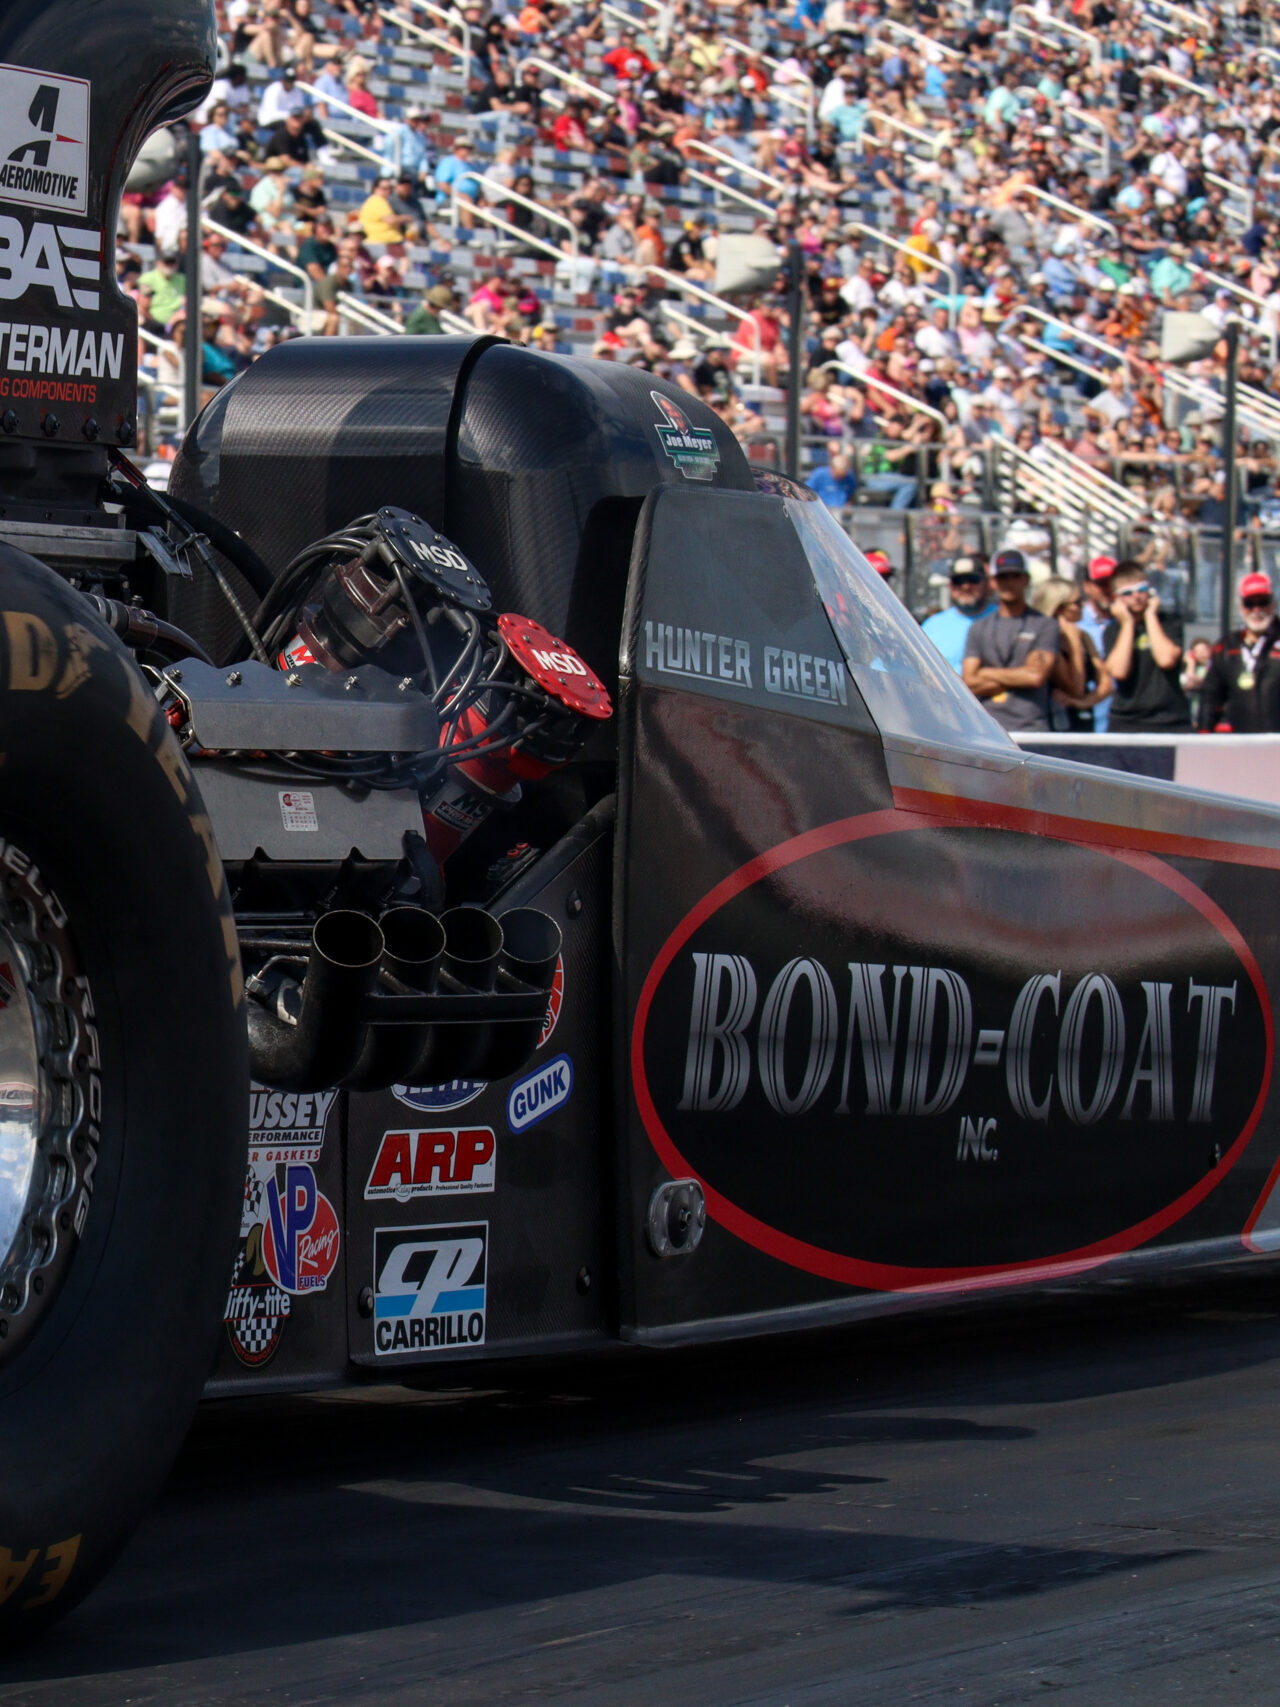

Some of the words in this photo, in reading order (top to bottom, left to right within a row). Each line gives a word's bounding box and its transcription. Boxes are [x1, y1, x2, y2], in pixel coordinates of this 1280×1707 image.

[12, 379, 97, 403] COMPONENTS
[666, 434, 683, 448] Joe
[682, 435, 712, 451] Meyer
[408, 540, 468, 572] MSD
[531, 648, 587, 677] MSD
[645, 621, 753, 688] HUNTER
[764, 646, 848, 706] GREEN
[676, 953, 1237, 1126] BOND-COAT
[74, 975, 102, 1240] RACING
[514, 1066, 567, 1119] GUNK
[266, 1149, 319, 1161] GASKETS
[369, 1129, 495, 1187] ARP
[266, 1165, 317, 1291] VP
[299, 1229, 340, 1274] Racing
[299, 1275, 326, 1287] FUELS
[375, 1312, 483, 1352] CARRILLO
